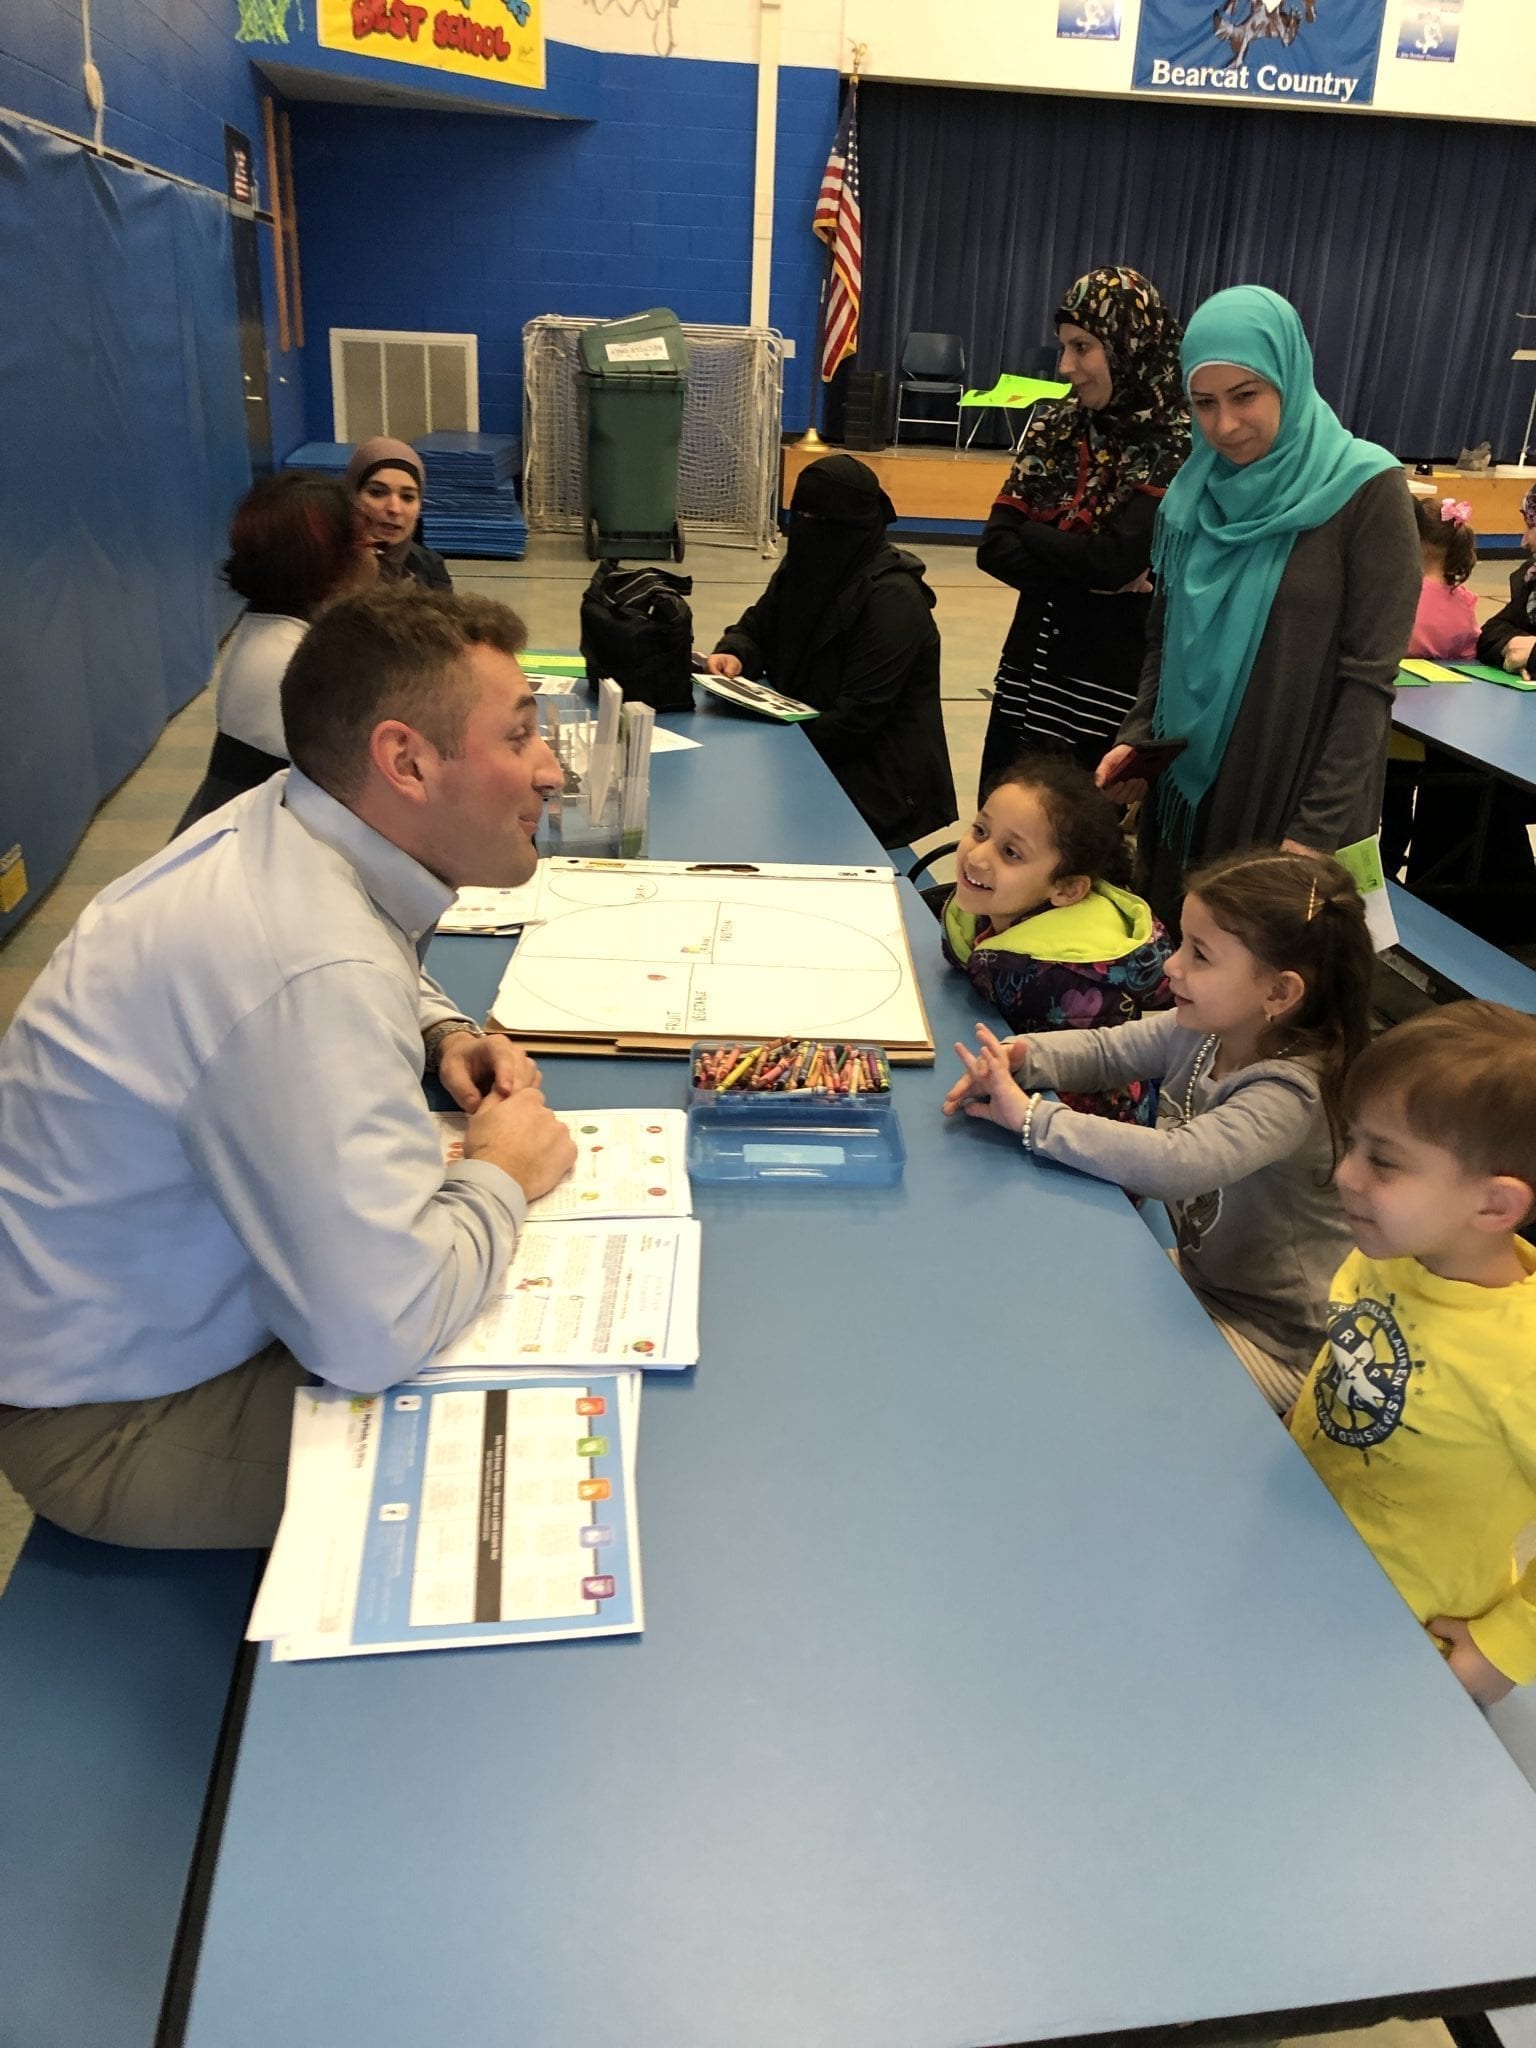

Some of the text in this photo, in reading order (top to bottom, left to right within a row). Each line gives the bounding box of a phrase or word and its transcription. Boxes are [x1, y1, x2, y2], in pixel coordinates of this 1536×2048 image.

[352, 0, 427, 42] BEST
[433, 10, 512, 61] SCHOOL
[1151, 59, 1359, 102] Bearcat Country
[720, 920, 733, 941] PROTEIN
[692, 991, 707, 1021] VEGETABLE
[665, 1010, 681, 1031] FRUIT
[1339, 1328, 1356, 1344] R
[1388, 1328, 1408, 1387] LAUREN
[1368, 1367, 1380, 1379] P
